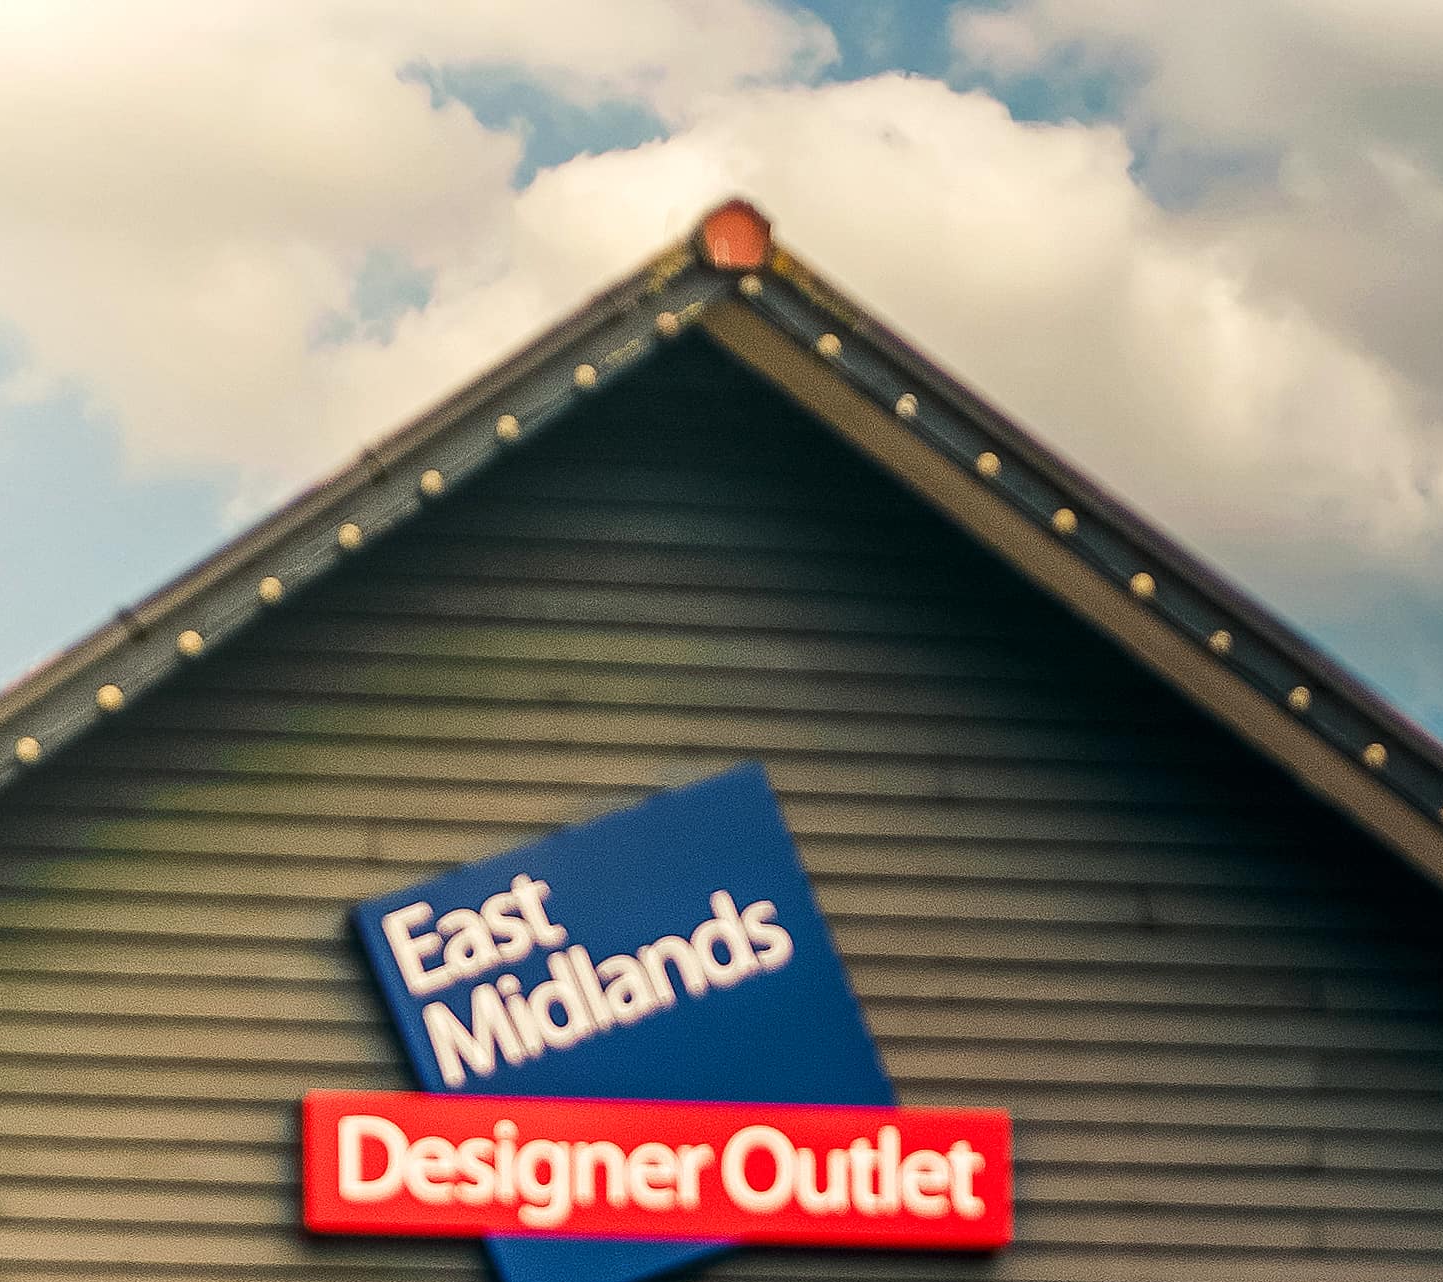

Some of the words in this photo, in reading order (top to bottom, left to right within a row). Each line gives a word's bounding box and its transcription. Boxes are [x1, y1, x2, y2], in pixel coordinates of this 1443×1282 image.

[384, 874, 566, 994] East
[424, 891, 792, 1087] Midlands
[337, 1113, 715, 1228] Designer
[721, 1124, 985, 1219] Outlet
